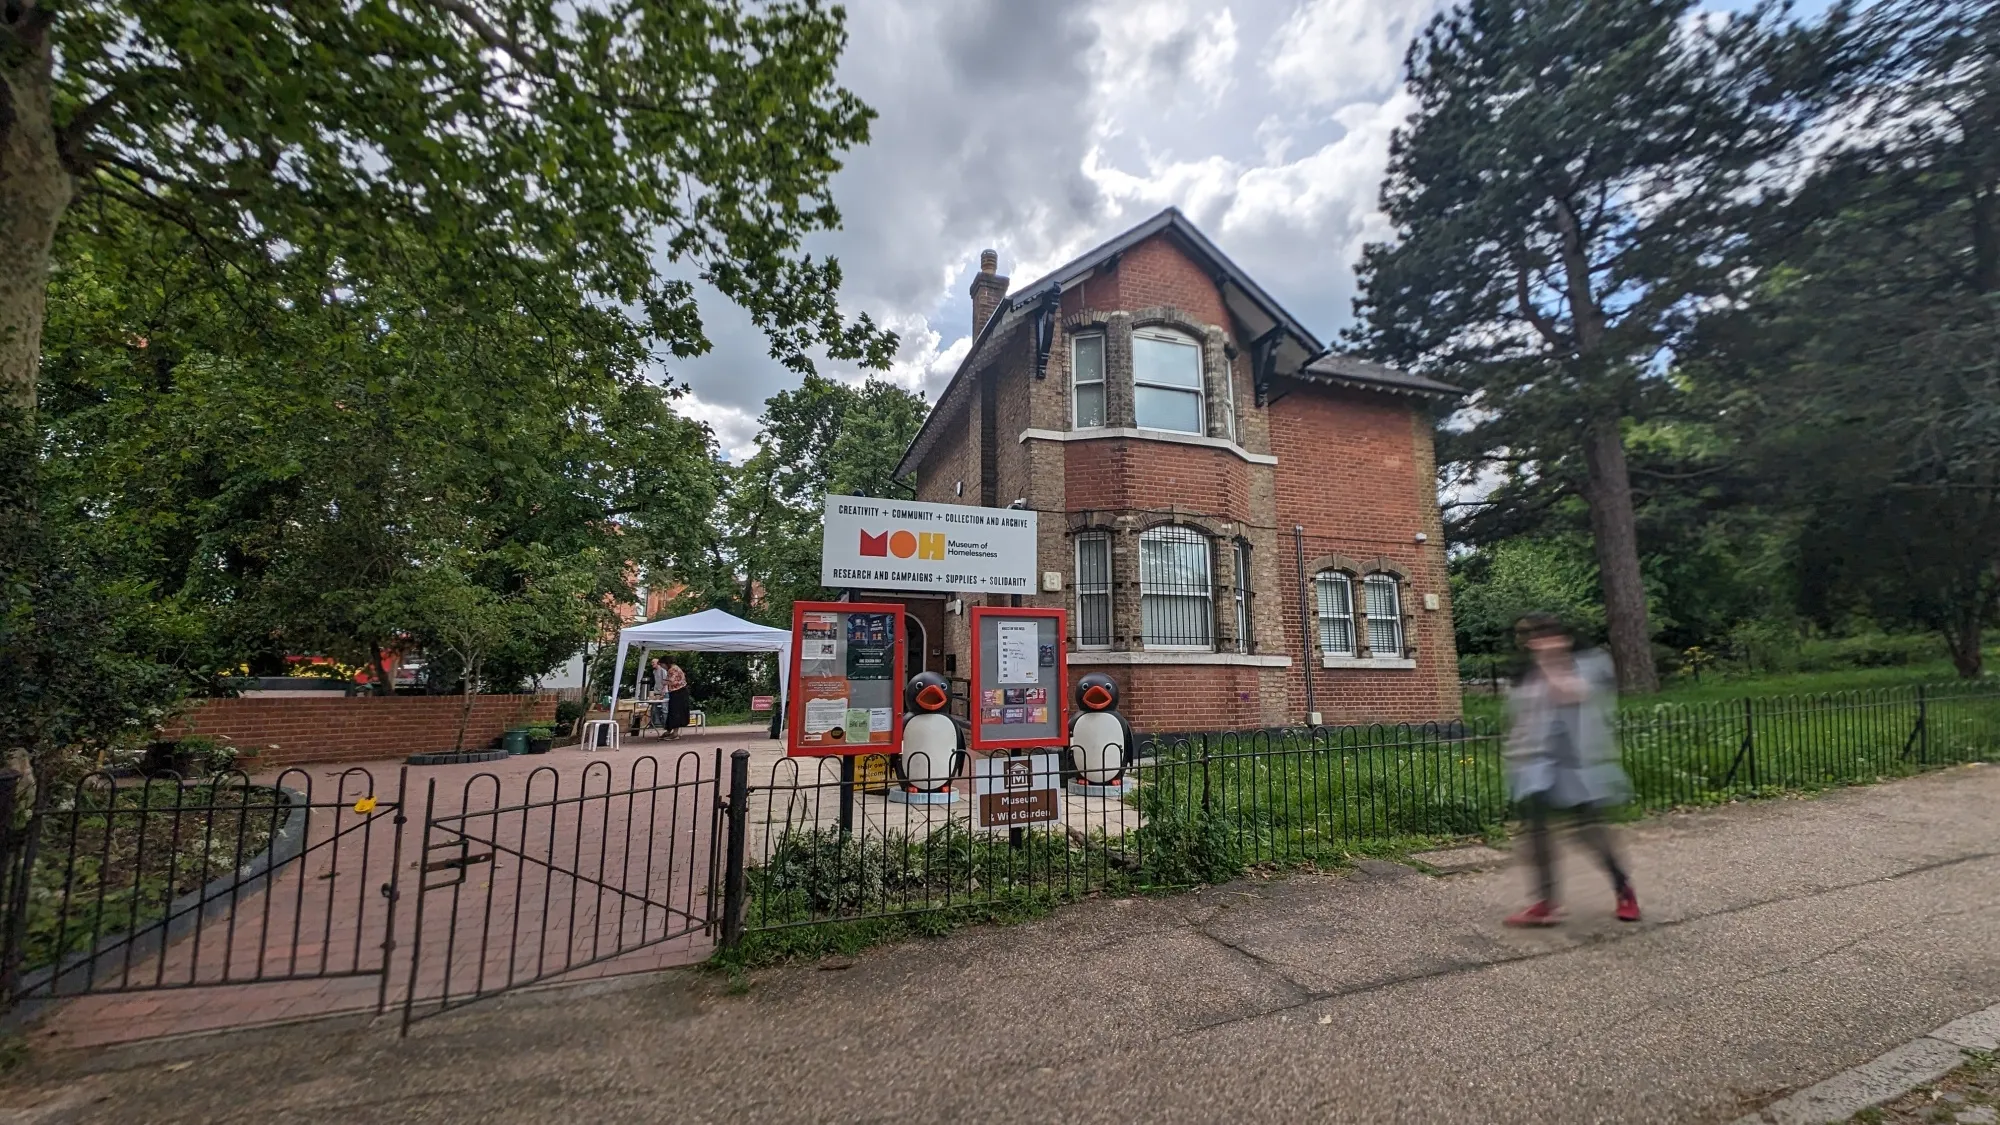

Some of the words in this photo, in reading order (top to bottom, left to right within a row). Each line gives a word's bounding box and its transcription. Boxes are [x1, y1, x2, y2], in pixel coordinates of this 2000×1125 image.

[838, 504, 880, 517] CREATIVITY
[891, 508, 934, 521] COMMUNITY
[945, 513, 985, 525] COLLECTION
[986, 516, 1000, 526] AND
[1001, 517, 1028, 529] ARCHIVE
[860, 528, 945, 560] MOH
[947, 540, 980, 549] Museum
[980, 542, 988, 550] of
[947, 548, 998, 559] Homelessness
[833, 568, 872, 580] RESEARCH
[874, 570, 889, 581] AND
[891, 571, 933, 583] CAMPAIGNS
[945, 573, 978, 585] SUPPLIES
[989, 576, 1027, 587] SOLIDARITY
[1001, 796, 1038, 805] Museum
[997, 811, 1017, 821] Wid
